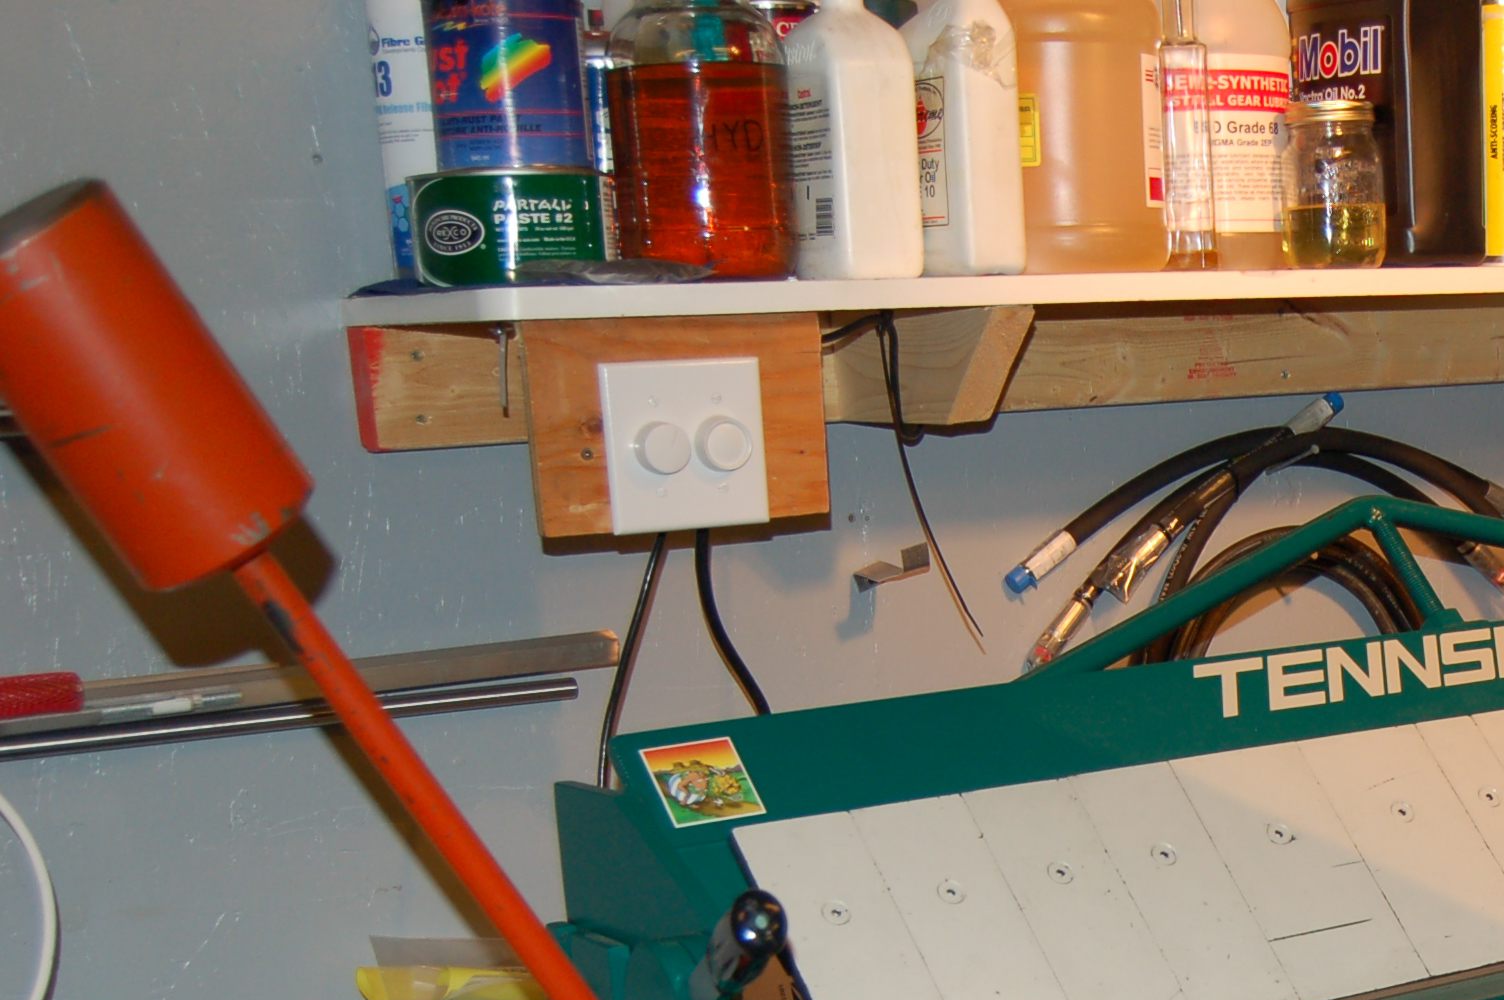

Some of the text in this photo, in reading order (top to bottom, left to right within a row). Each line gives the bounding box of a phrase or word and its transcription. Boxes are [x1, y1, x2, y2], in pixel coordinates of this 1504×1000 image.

[381, 37, 411, 48] Fibre
[1299, 26, 1381, 82] Mobil
[1227, 94, 1261, 107] GEAR
[1227, 120, 1266, 134] Grade
[1269, 122, 1279, 135] 68
[1489, 104, 1498, 160] ANTI-SCORING
[921, 158, 940, 173] Duty
[925, 185, 936, 198] 10
[494, 212, 550, 224] PSTE
